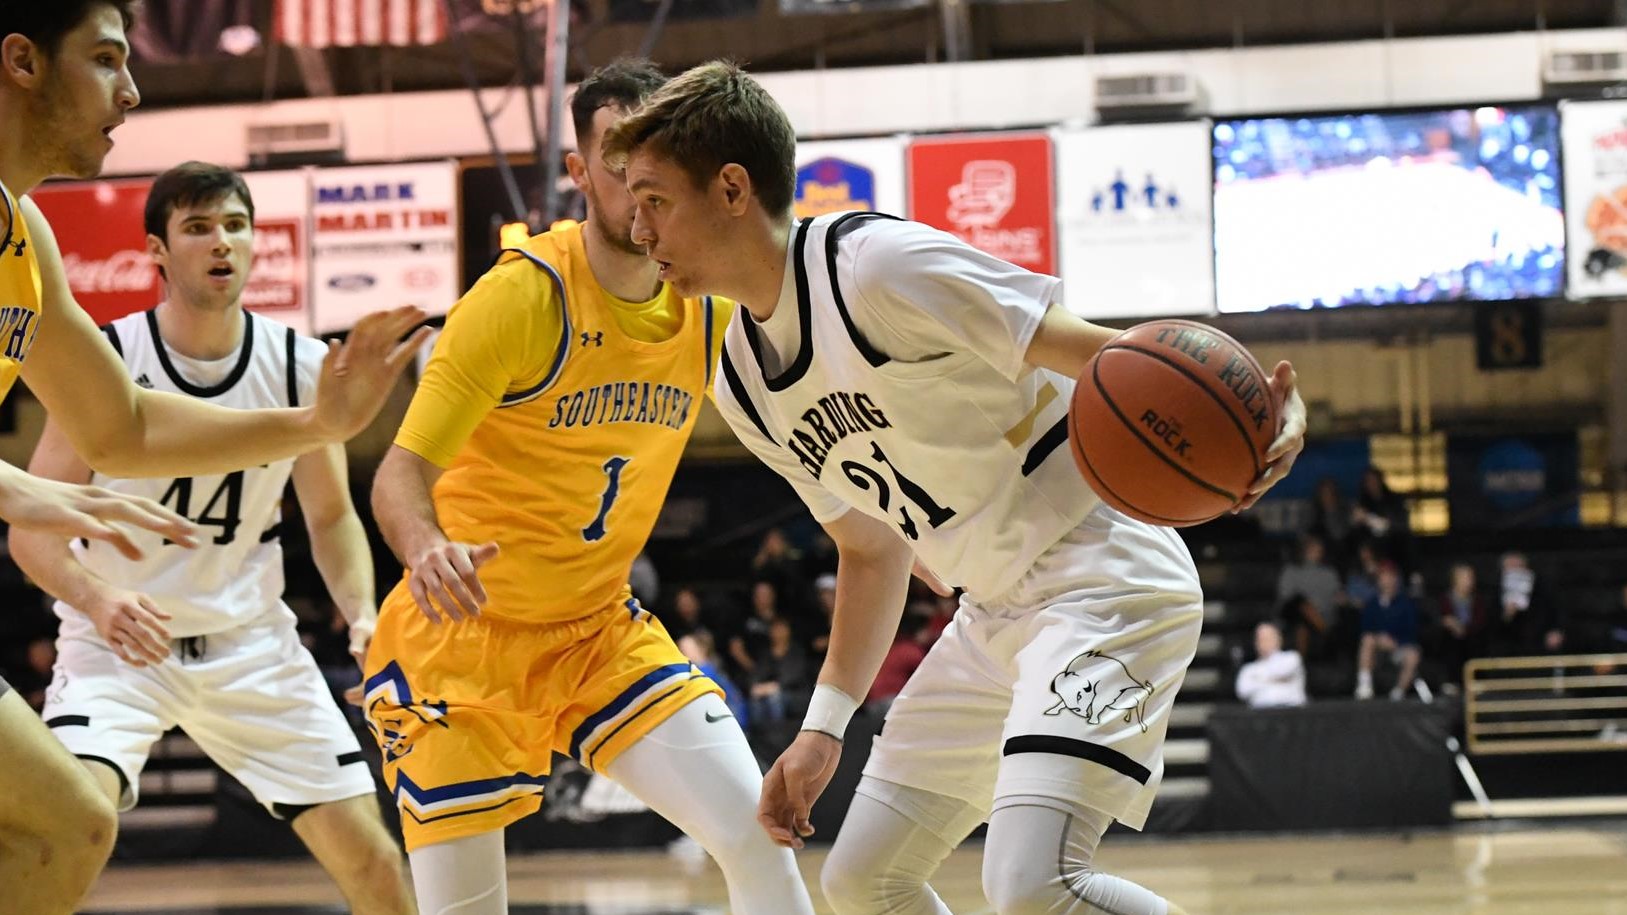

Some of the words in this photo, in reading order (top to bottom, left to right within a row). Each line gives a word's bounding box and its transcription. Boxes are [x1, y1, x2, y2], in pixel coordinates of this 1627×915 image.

[319, 184, 413, 203] MARK
[319, 212, 448, 233] MARTIN
[1218, 352, 1269, 433] ROCK
[788, 391, 893, 481] HARDING
[1140, 408, 1192, 458] ROCK
[159, 470, 244, 546] 44
[582, 457, 631, 541] 1
[841, 440, 957, 541] 21
